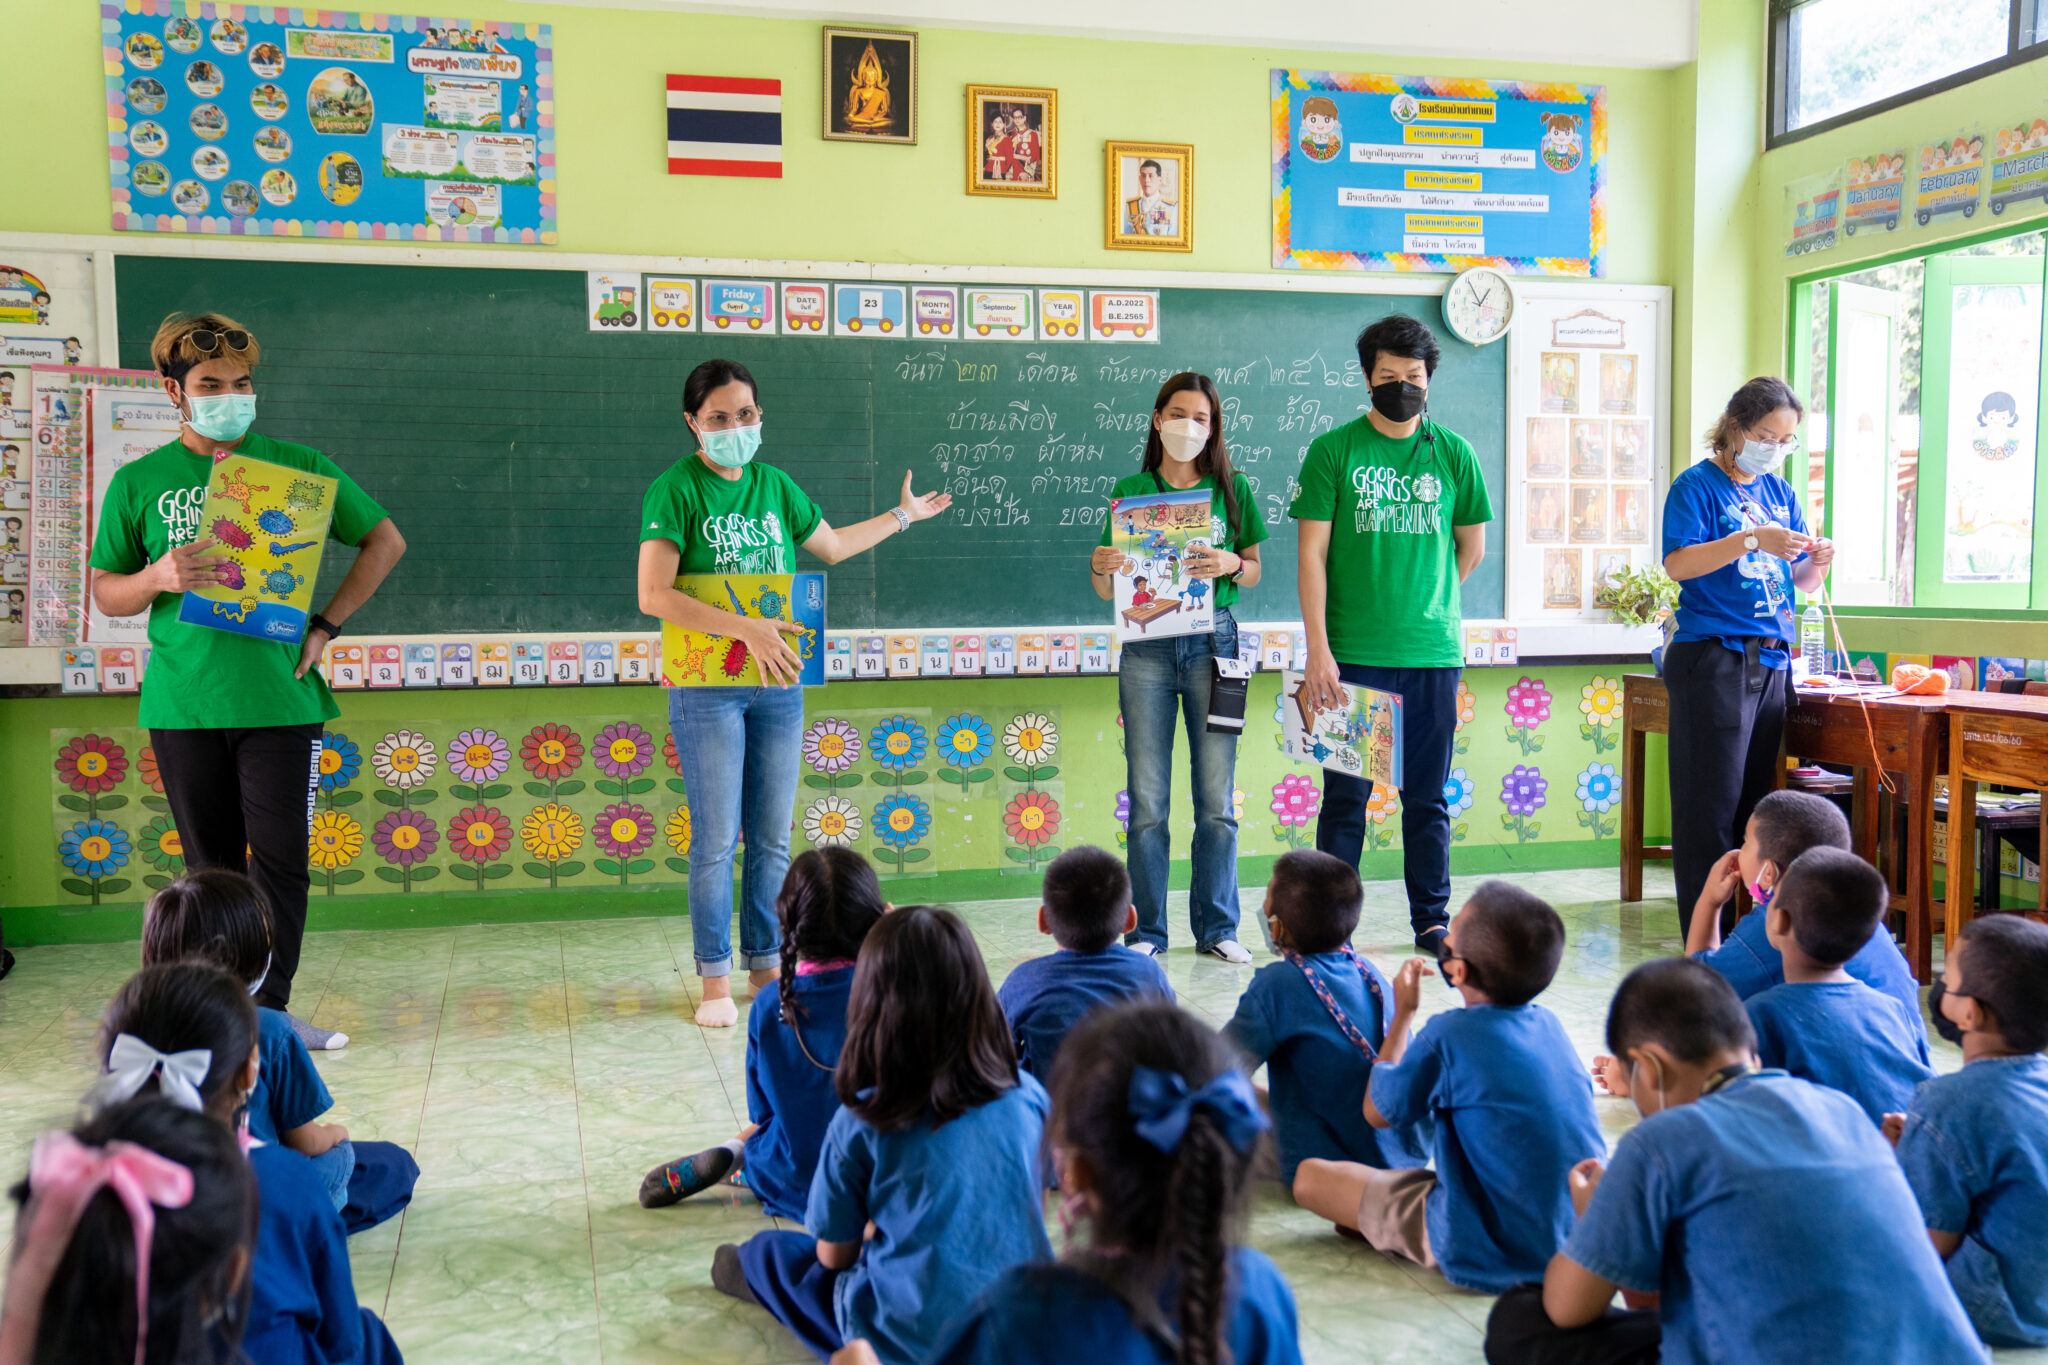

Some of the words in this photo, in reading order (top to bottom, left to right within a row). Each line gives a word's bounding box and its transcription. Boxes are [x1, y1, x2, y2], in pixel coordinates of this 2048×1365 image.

[412, 55, 517, 73] เศรษฐกิจพอเพียง
[1920, 168, 1980, 192] February
[1850, 184, 1896, 205] January
[722, 288, 755, 302] Friday
[796, 296, 817, 304] DATE
[864, 298, 878, 308] 23
[922, 301, 950, 309] MONTH
[983, 303, 1016, 312] September
[1108, 299, 1144, 307] A.D.2022
[1108, 312, 1144, 320] B.E.2565
[896, 345, 947, 381] วันที่
[953, 359, 998, 382] ๒๓
[1018, 352, 1078, 382] เดือน
[41, 394, 50, 413] 1
[123, 411, 133, 419] 20
[947, 398, 1057, 431] บ้านเมือง
[1277, 394, 1334, 434] น้ำใจ
[38, 426, 52, 445] 6
[929, 436, 1014, 472] ลูกสาว
[1039, 432, 1104, 462] ผ้าห่ม
[40, 480, 52, 488] 21
[59, 480, 71, 488] 22
[1353, 466, 1397, 490] GOOD
[1354, 476, 1411, 502] THINGS
[39, 499, 52, 508] 31
[59, 500, 71, 509] 32
[1357, 499, 1380, 510] ARE
[38, 520, 51, 528] 41
[59, 520, 72, 529] 42
[1354, 503, 1442, 534] HAPPENING
[702, 512, 746, 544] GOOD
[168, 528, 197, 542] ARE
[709, 518, 768, 552] THINGS
[39, 539, 51, 548] 51
[58, 540, 71, 548] 52
[38, 560, 51, 568] 61
[715, 550, 742, 566] ARE
[57, 580, 69, 589] 72
[37, 600, 49, 608] 81
[36, 620, 48, 628] 91
[278, 622, 297, 632] Planet
[1272, 651, 1280, 662] ล
[1475, 647, 1483, 657] อ
[1501, 646, 1509, 657] ฮ
[832, 658, 842, 670] ถ
[865, 658, 876, 670] ท
[900, 657, 908, 670] ธ
[930, 657, 942, 668] น
[961, 656, 972, 668] บ
[994, 652, 1005, 668] ป
[1027, 655, 1037, 667] ผ
[1058, 652, 1068, 667] ฝ
[1089, 655, 1100, 666] พ
[343, 668, 353, 680] จ
[380, 668, 391, 680] ฉ
[487, 665, 502, 678] ฌ
[521, 664, 537, 680] ญ
[629, 661, 639, 678] ฐ
[74, 672, 86, 685] ก
[113, 672, 125, 685] ข
